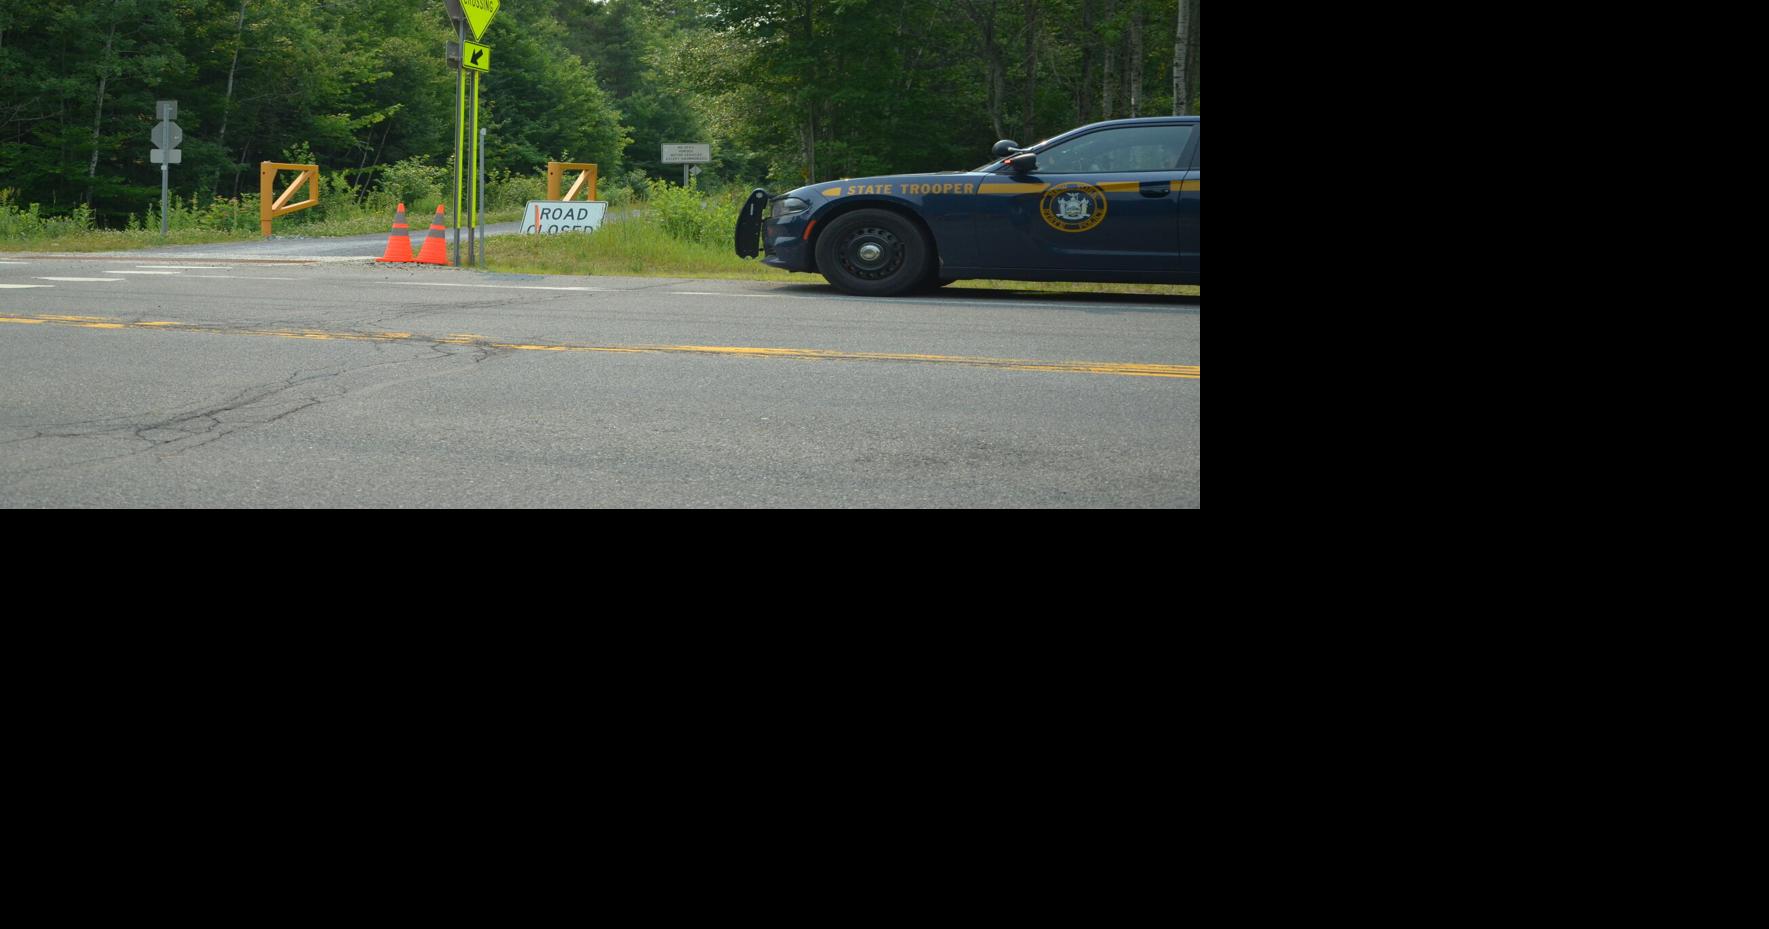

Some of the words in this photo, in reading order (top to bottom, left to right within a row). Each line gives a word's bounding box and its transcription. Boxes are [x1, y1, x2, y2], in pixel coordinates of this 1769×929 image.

[847, 184, 893, 195] STATE
[901, 183, 974, 194] TROOPER
[540, 207, 588, 220] ROAD
